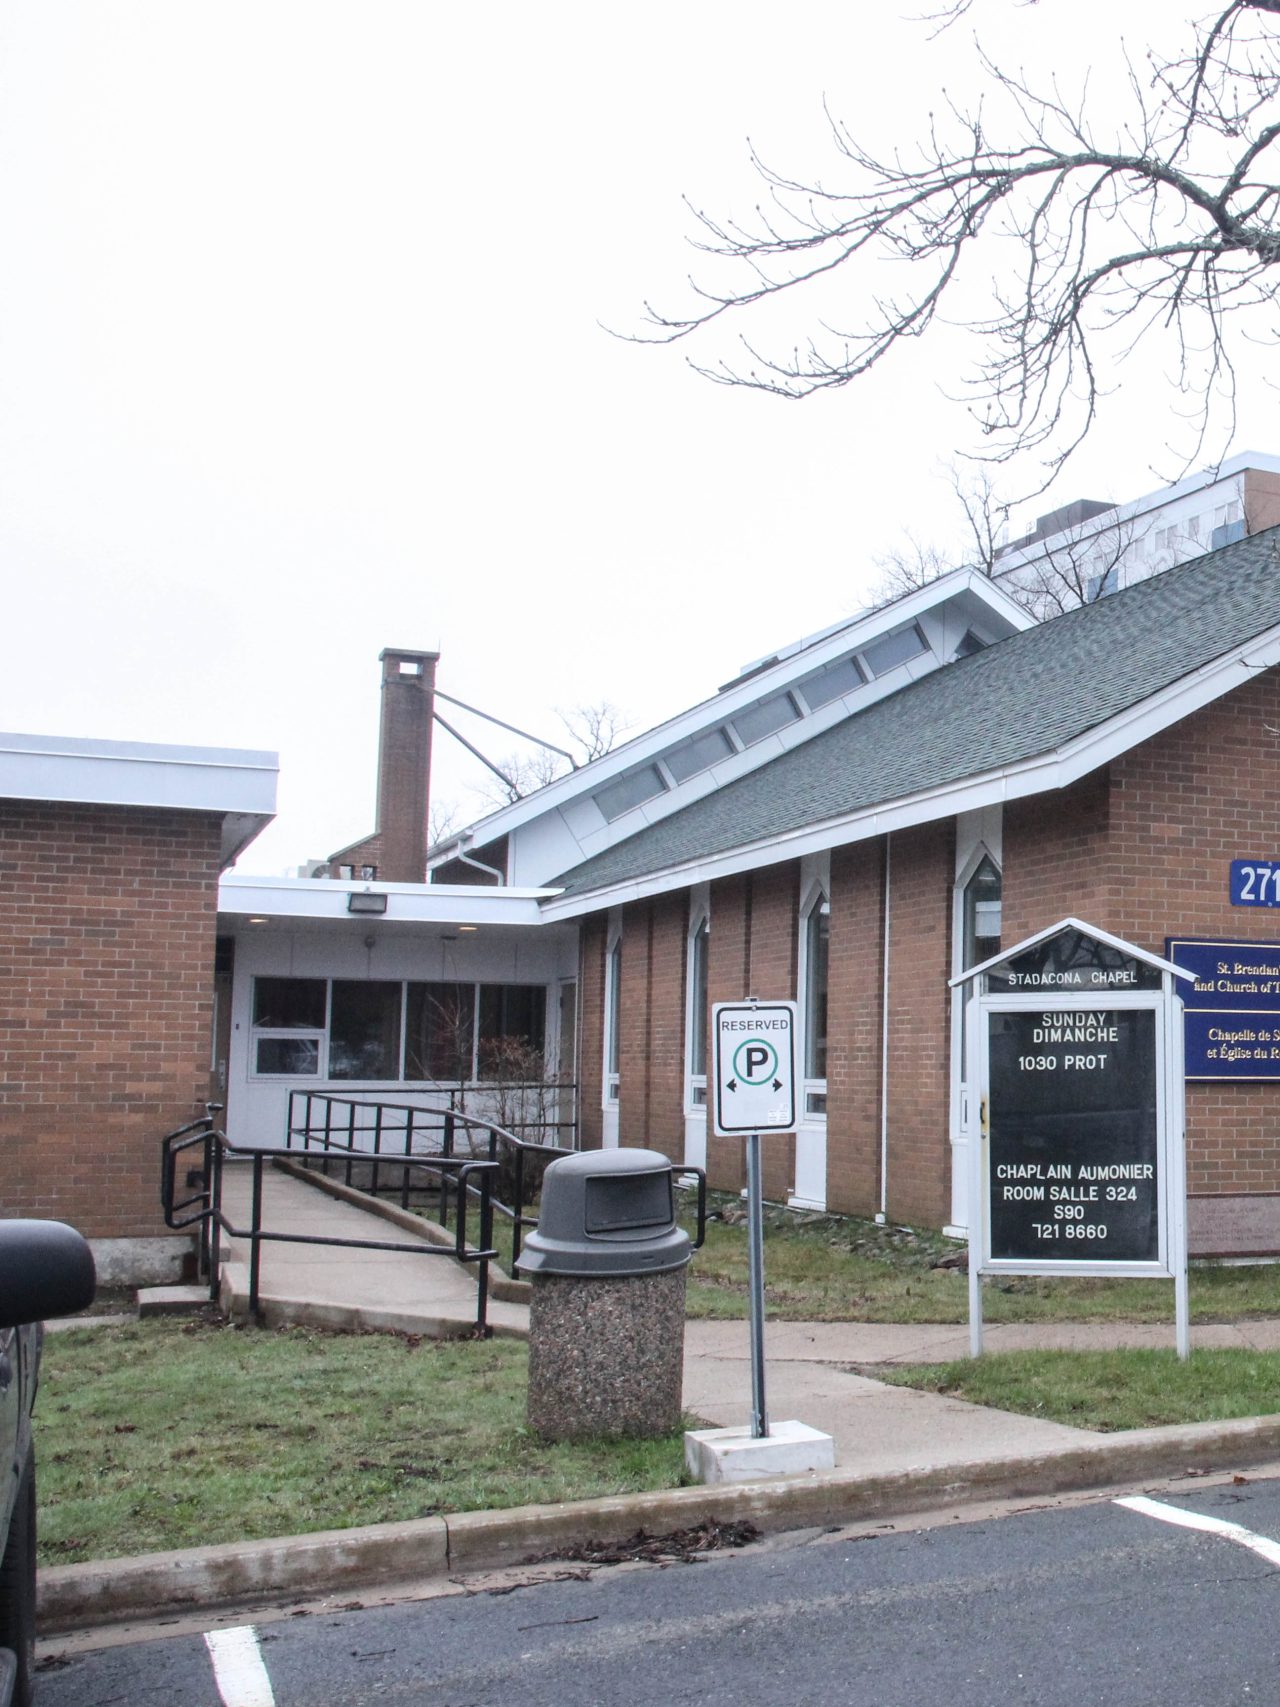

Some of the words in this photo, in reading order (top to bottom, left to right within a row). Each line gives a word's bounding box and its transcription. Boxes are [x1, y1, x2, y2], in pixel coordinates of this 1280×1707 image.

[1217, 962, 1231, 974] St.
[1008, 972, 1081, 985] STADACONA
[1091, 971, 1138, 984] CHAPEL
[1217, 980, 1258, 993] Church
[1260, 981, 1272, 993] of
[721, 1019, 789, 1031] RESERVED
[1042, 1012, 1106, 1027] SUNDAY
[1033, 1027, 1119, 1043] DIMANCHE
[1208, 1028, 1256, 1044] Chapelle
[1258, 1030, 1271, 1041] de
[1207, 1048, 1217, 1058] et
[1220, 1043, 1251, 1061] Église
[1254, 1047, 1267, 1059] du
[746, 1047, 769, 1077] P
[1018, 1055, 1057, 1071] 1030
[1064, 1054, 1108, 1070] PROT
[997, 1164, 1072, 1179] CHAPLAIN
[1078, 1164, 1154, 1180] AUMONIER
[1003, 1186, 1045, 1200] ROOM
[1050, 1186, 1099, 1201] SALLE
[1106, 1186, 1138, 1201] 324
[1054, 1205, 1085, 1220] S90
[1032, 1224, 1059, 1239] 721
[1065, 1224, 1108, 1239] 8660
